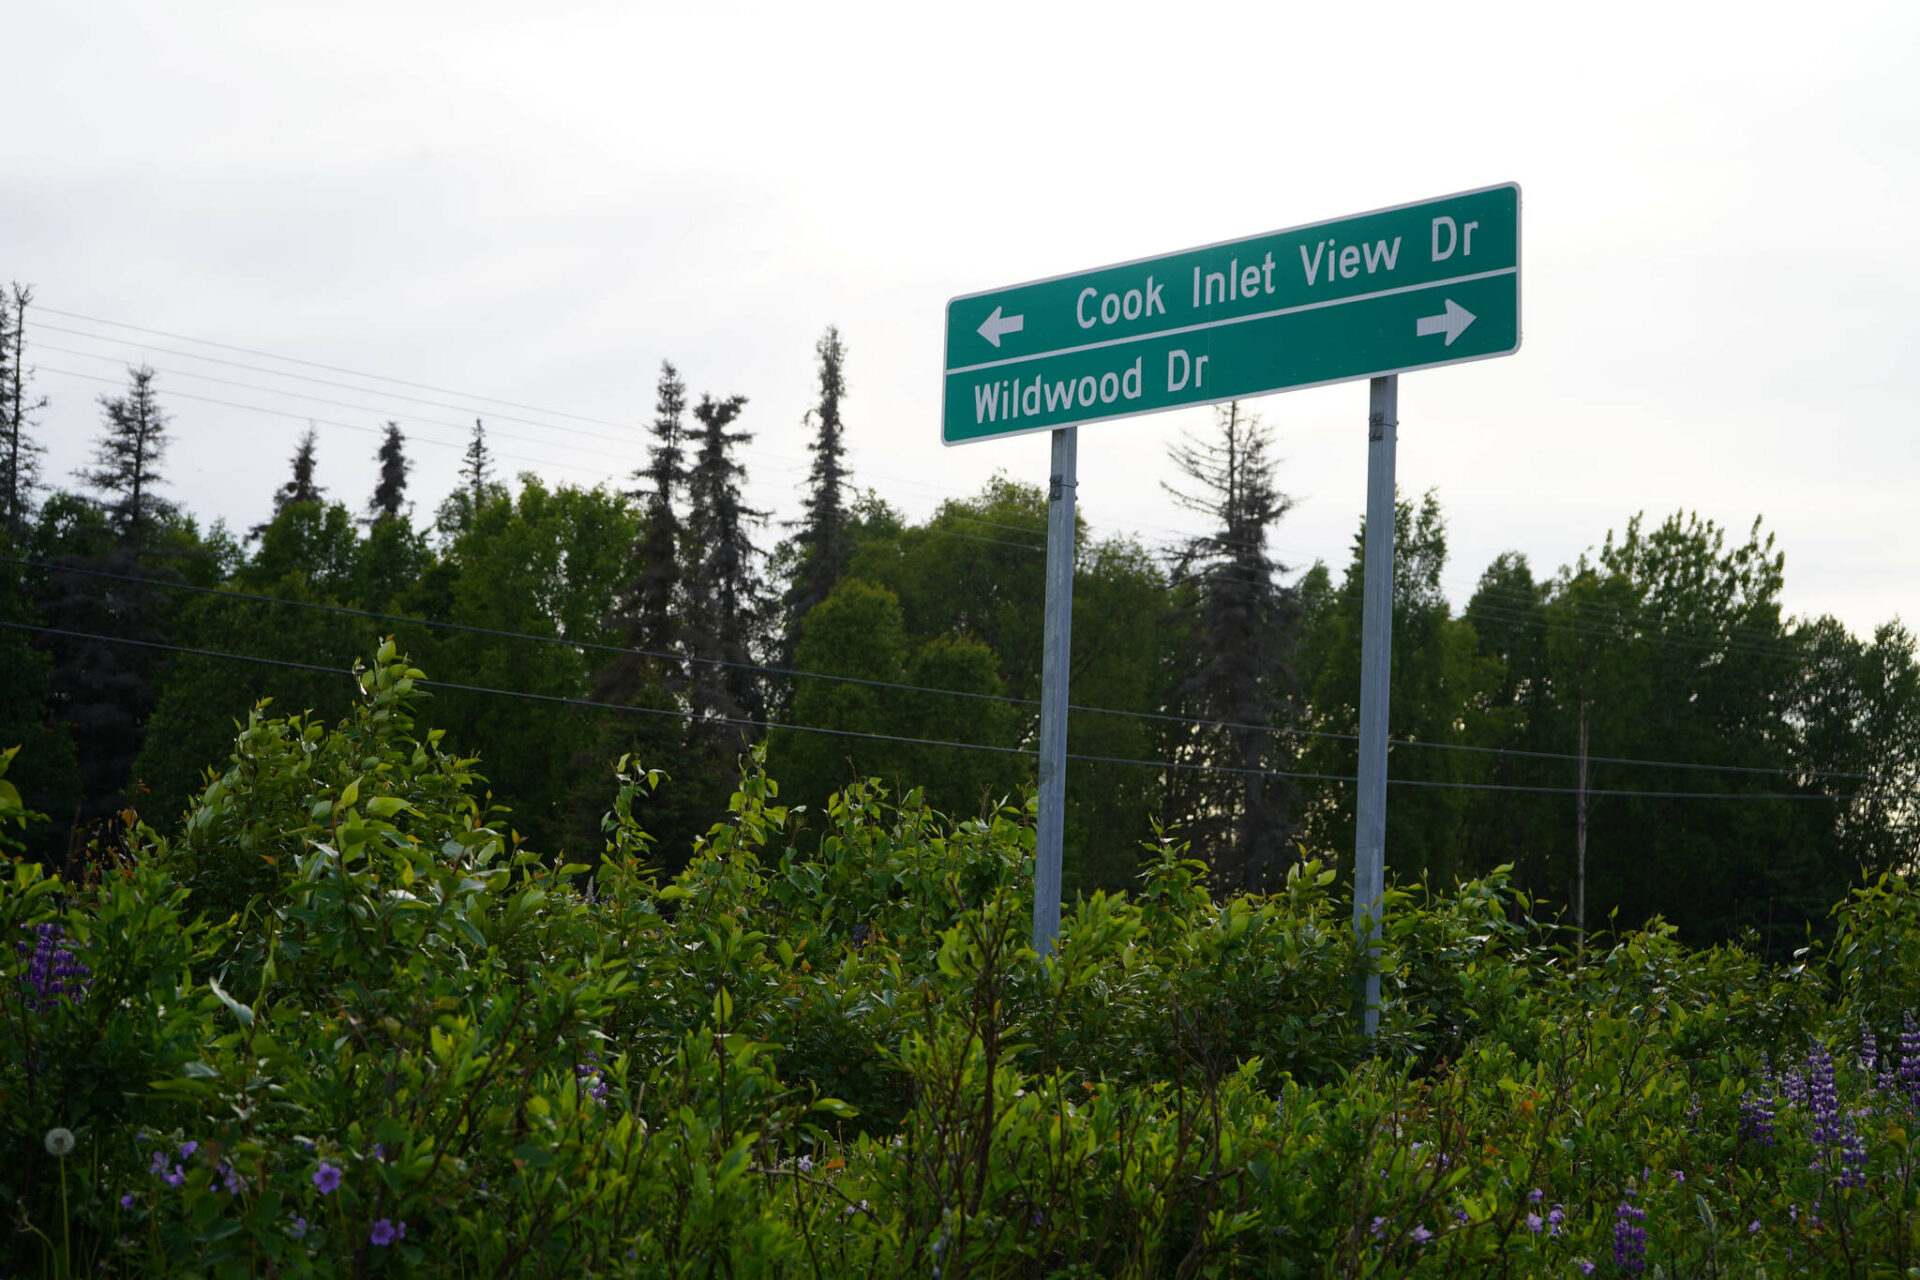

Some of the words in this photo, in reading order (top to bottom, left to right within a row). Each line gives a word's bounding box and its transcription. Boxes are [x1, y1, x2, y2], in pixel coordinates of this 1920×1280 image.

[1076, 275, 1166, 329] Cook
[1193, 252, 1276, 308] Inlet
[1300, 237, 1401, 286] View
[1431, 216, 1478, 262] Dr
[974, 356, 1142, 424] Wildwood
[1167, 349, 1209, 392] Dr
